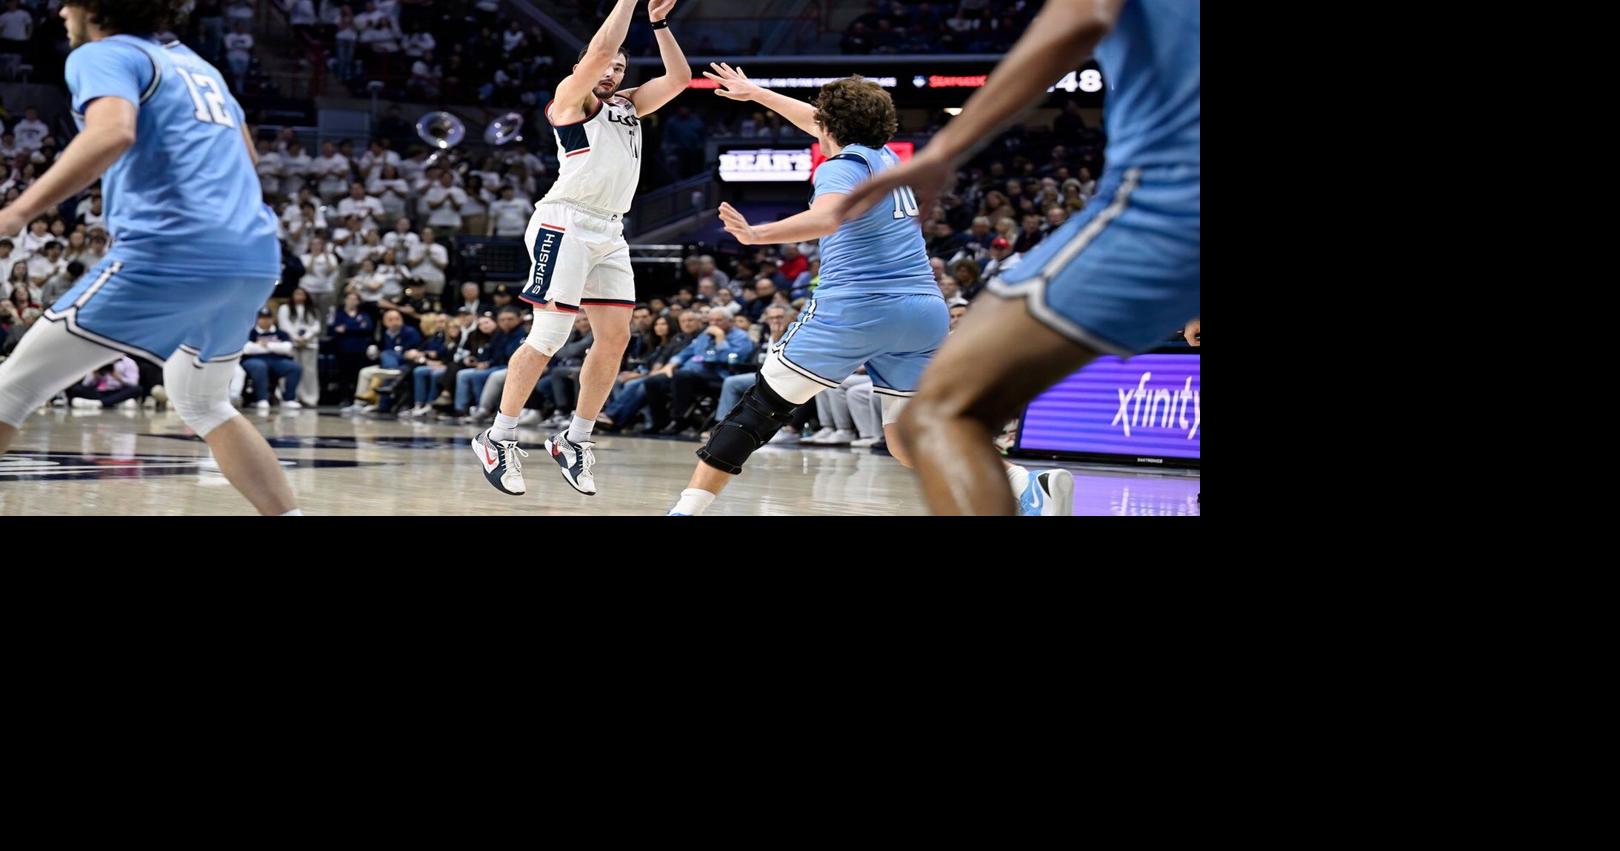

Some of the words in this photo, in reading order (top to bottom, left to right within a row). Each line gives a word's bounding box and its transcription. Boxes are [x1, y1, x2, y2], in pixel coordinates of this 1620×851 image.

[176, 66, 235, 128] 12
[532, 233, 556, 295] HUSKIES
[1111, 371, 1200, 440] xfinity
